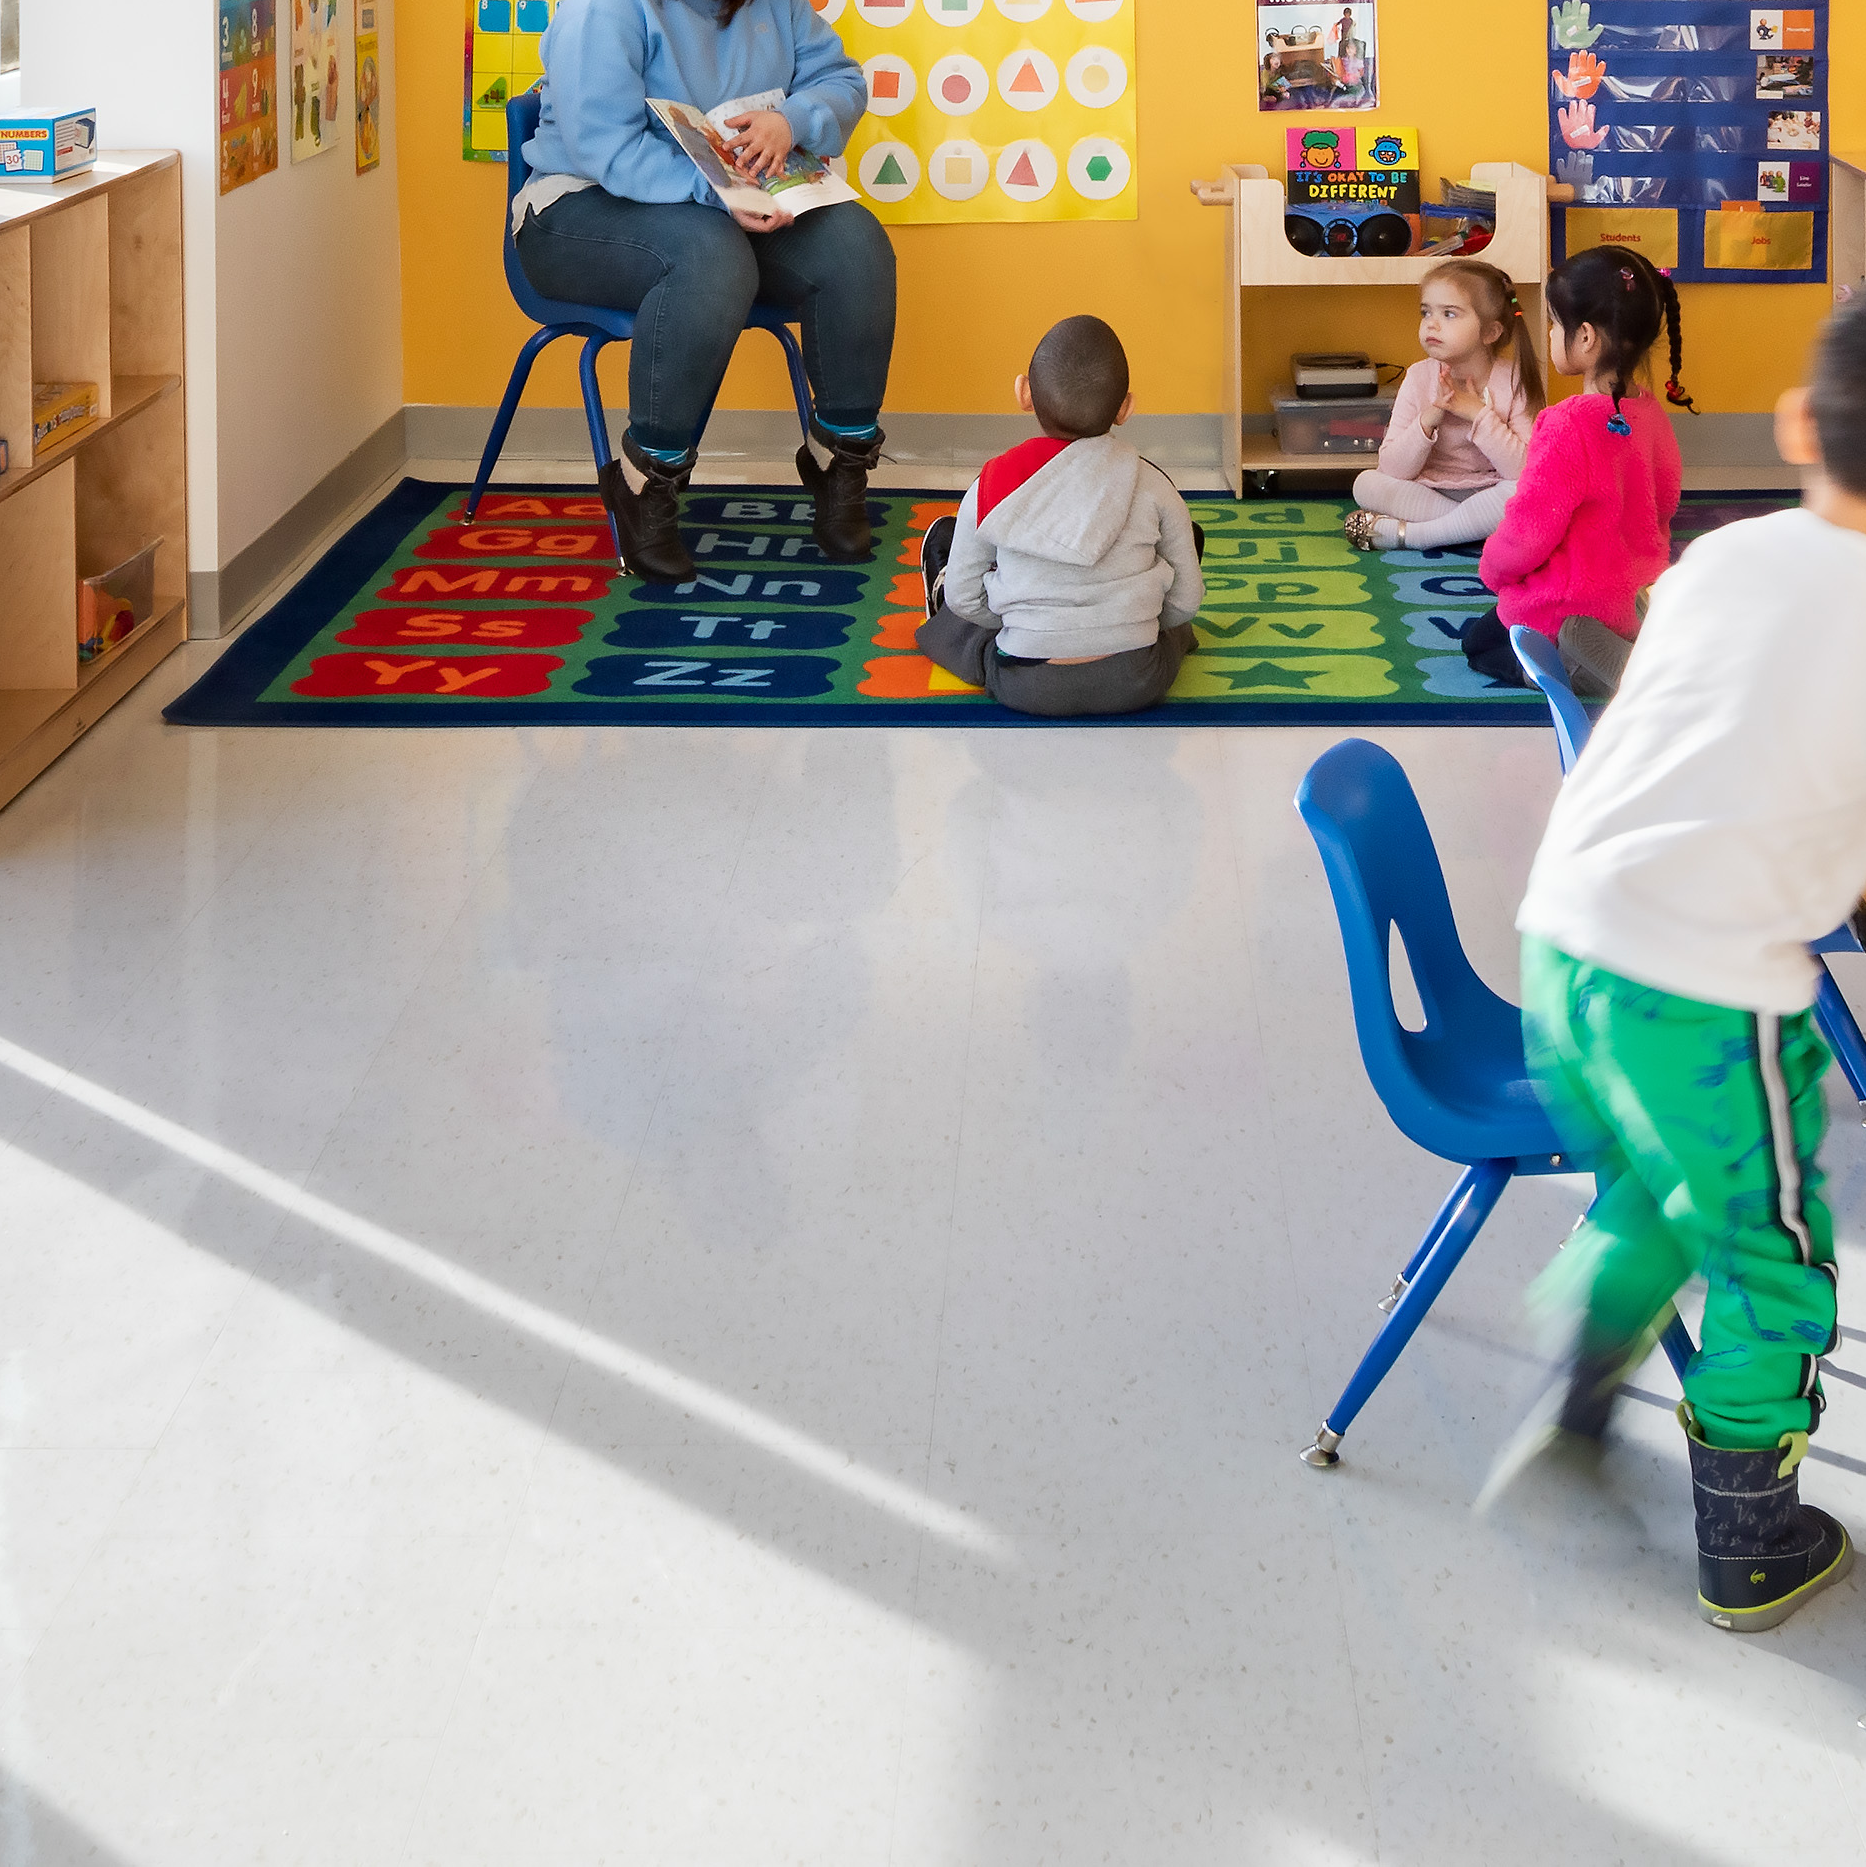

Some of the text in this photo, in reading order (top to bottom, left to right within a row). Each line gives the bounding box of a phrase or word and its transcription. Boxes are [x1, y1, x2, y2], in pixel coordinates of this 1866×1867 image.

[481, 0, 527, 10] 8 9
[222, 16, 230, 48] 3
[251, 8, 258, 38] 8
[222, 77, 230, 109] 4
[0, 130, 48, 139] NUMBERS
[6, 154, 20, 165] 30
[1295, 171, 1323, 183] IT'S
[1327, 171, 1365, 183] OKAY
[1390, 171, 1408, 183] BE
[1308, 184, 1398, 200] DIFFERENT
[1600, 232, 1641, 243] Students
[1751, 236, 1771, 245] Jobs
[457, 528, 599, 556] Gg
[397, 570, 593, 594] Mm
[675, 574, 822, 597] Nn
[395, 614, 528, 638] Ss
[680, 616, 787, 640] Tt
[362, 660, 502, 694] Yy
[632, 661, 776, 686] Zz
